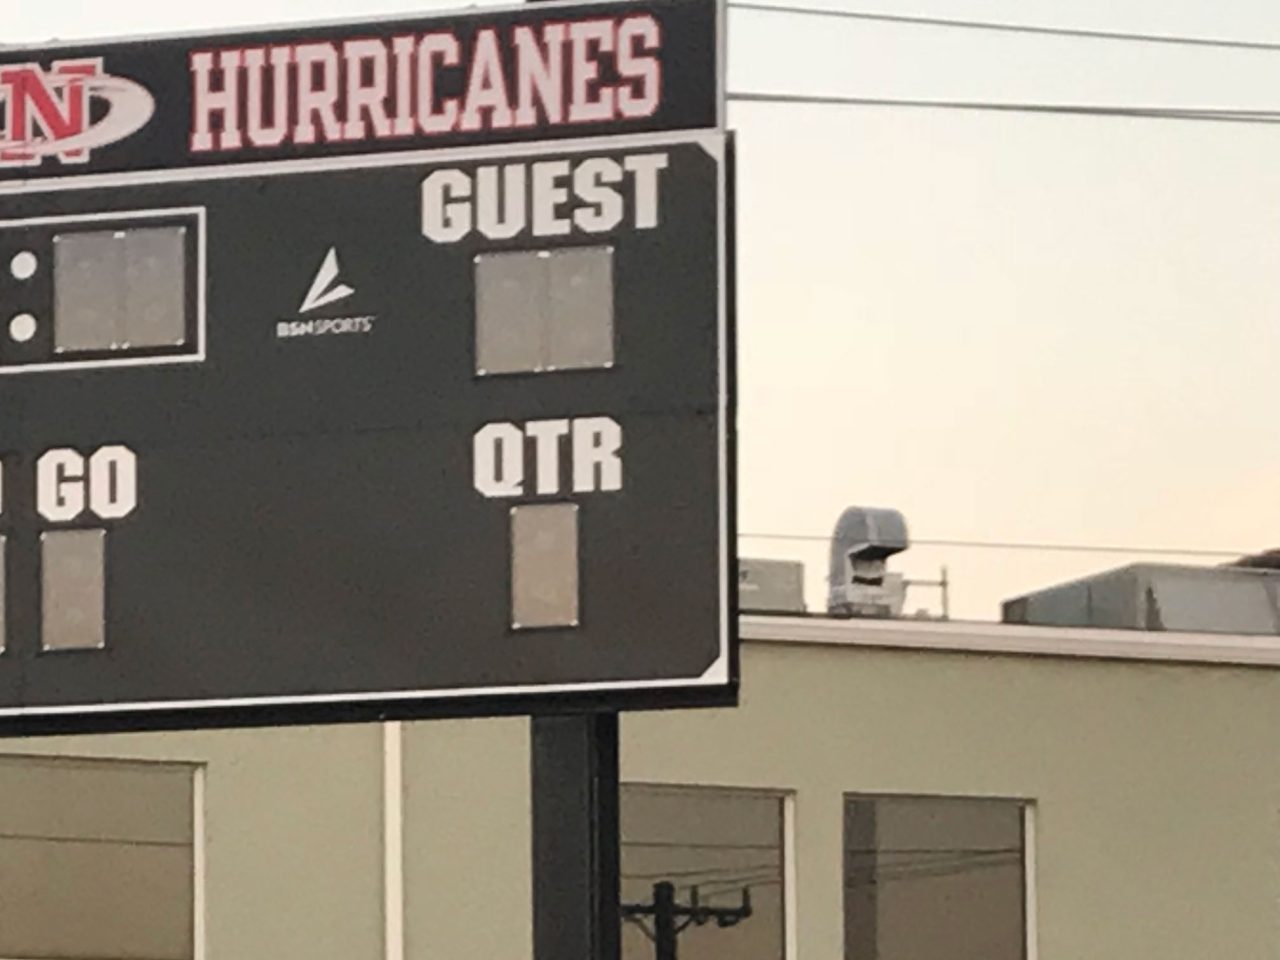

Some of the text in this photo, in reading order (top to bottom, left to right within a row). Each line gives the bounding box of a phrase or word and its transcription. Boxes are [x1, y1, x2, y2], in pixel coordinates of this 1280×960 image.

[190, 14, 662, 153] HURRICANES
[421, 153, 669, 244] GUEST
[36, 445, 138, 522] GO
[473, 416, 623, 499] QTR
